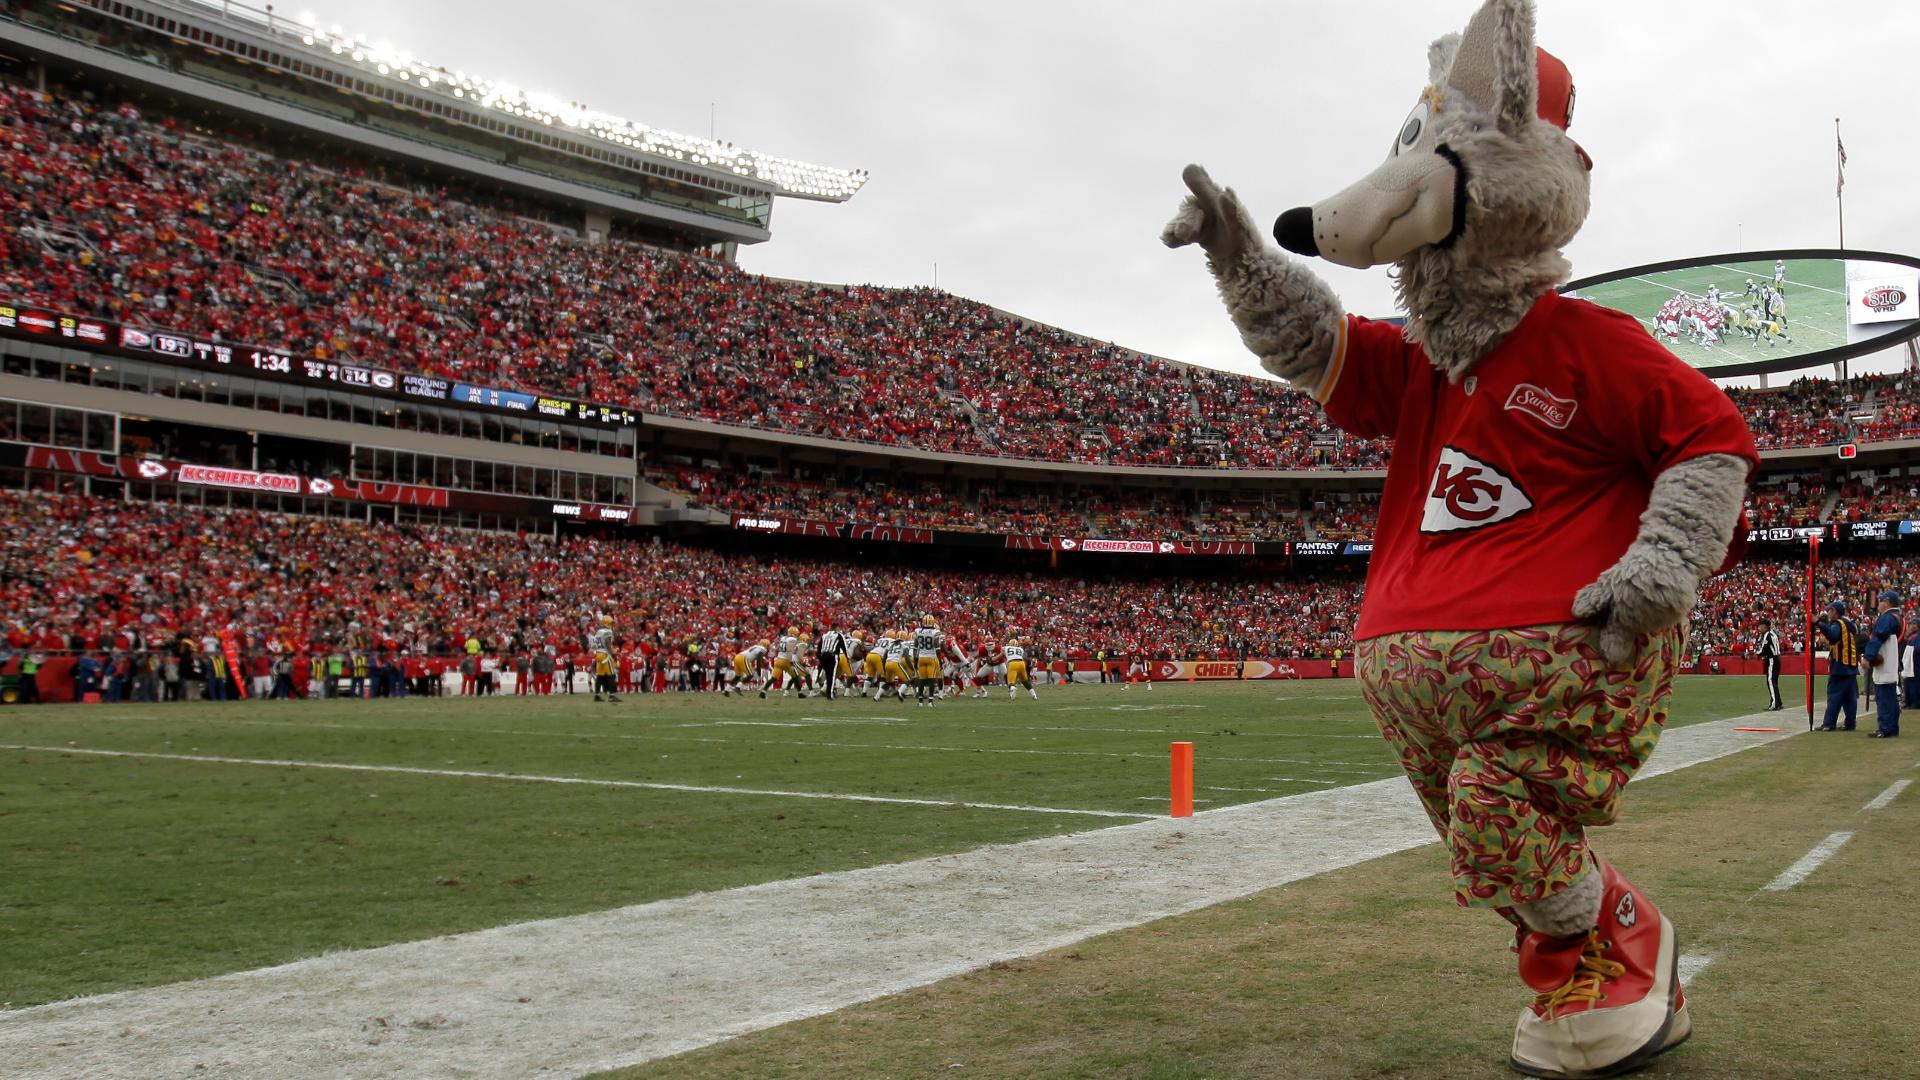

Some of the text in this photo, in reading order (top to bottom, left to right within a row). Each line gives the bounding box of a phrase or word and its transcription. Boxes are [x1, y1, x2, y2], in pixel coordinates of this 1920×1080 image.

[1869, 291, 1901, 306] 810
[159, 338, 177, 352] 19
[217, 354, 231, 363] 10
[251, 352, 291, 373] 1:34
[330, 372, 337, 380] 4
[354, 371, 368, 383] 14
[373, 374, 394, 388] G
[403, 376, 447, 390] AROUND
[405, 385, 446, 399] LEAGUE
[469, 387, 481, 396] JAX
[469, 395, 481, 403] ATL
[507, 401, 527, 410] FINAL
[538, 405, 565, 416] TURNER
[183, 467, 297, 489] KCCHIEFS.COM
[1432, 464, 1502, 521] KC
[553, 505, 628, 519] NEWS VIDEO
[739, 518, 780, 528] PRO SHOP
[1085, 541, 1152, 550] KCCHIEFS.COM
[918, 636, 933, 650] 38
[1195, 663, 1237, 677] CHIEF
